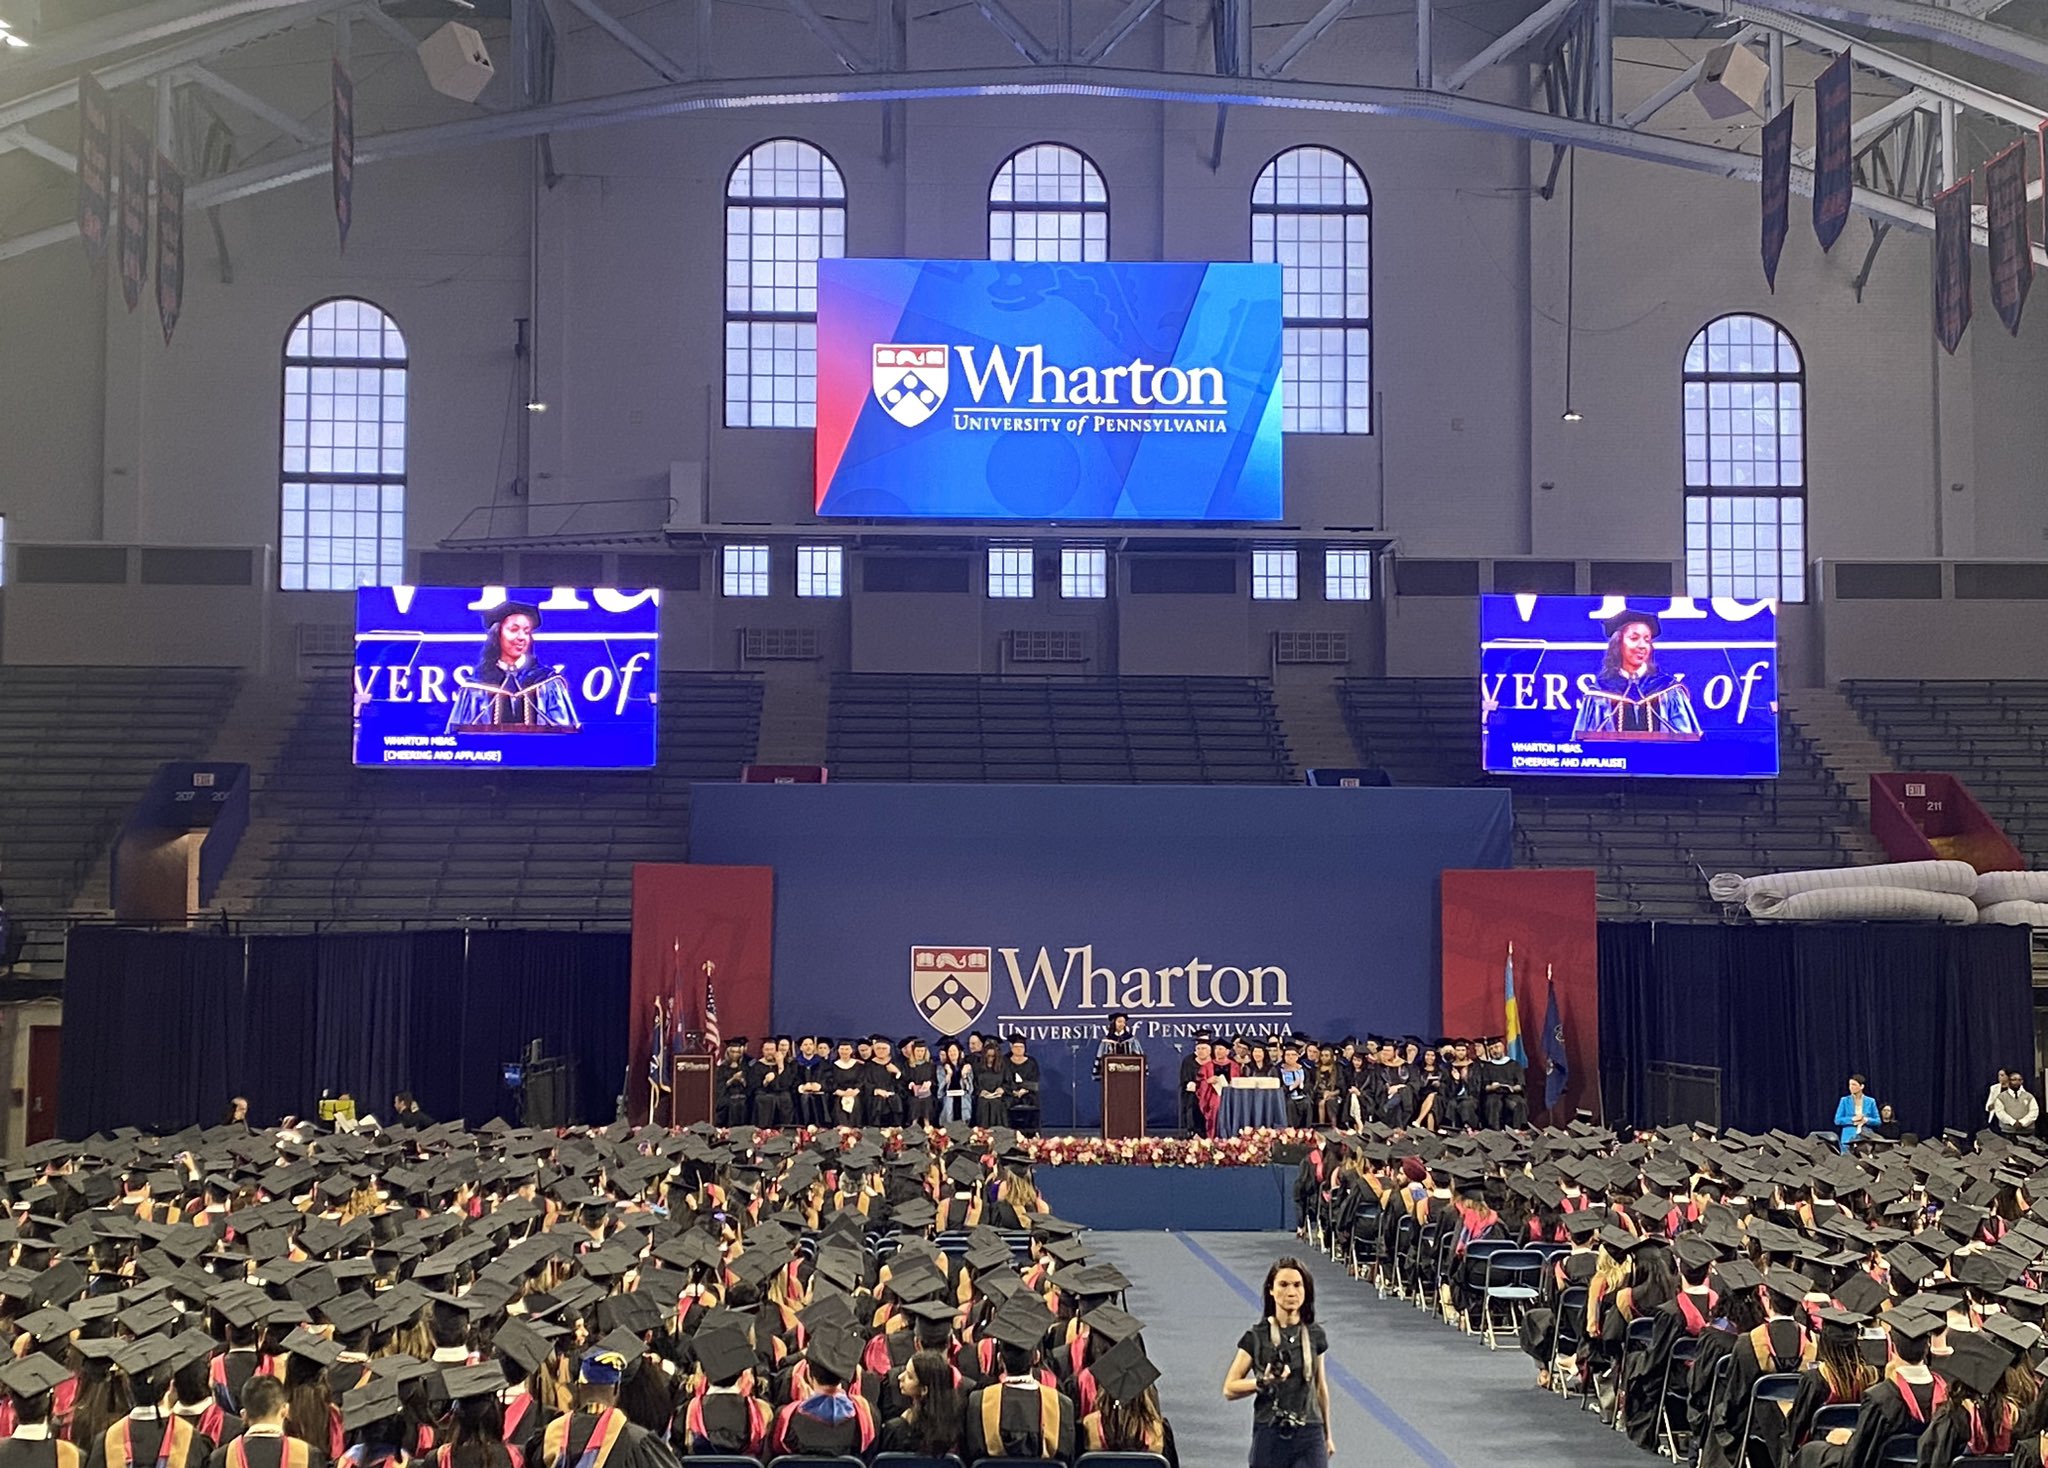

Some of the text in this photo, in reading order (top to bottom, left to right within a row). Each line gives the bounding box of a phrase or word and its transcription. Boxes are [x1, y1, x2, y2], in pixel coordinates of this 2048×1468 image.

[954, 344, 1227, 405] Wharton
[954, 415, 1227, 435] UNIVERSITY of PENNSYLVANIA
[583, 652, 650, 715] of
[1703, 661, 1769, 724] of
[433, 751, 453, 760] AND
[1512, 743, 1555, 753] WHARTON
[1560, 758, 1579, 768] AND
[175, 791, 195, 801] 207
[1927, 801, 1942, 811] 211
[998, 945, 1292, 1010] Wharton
